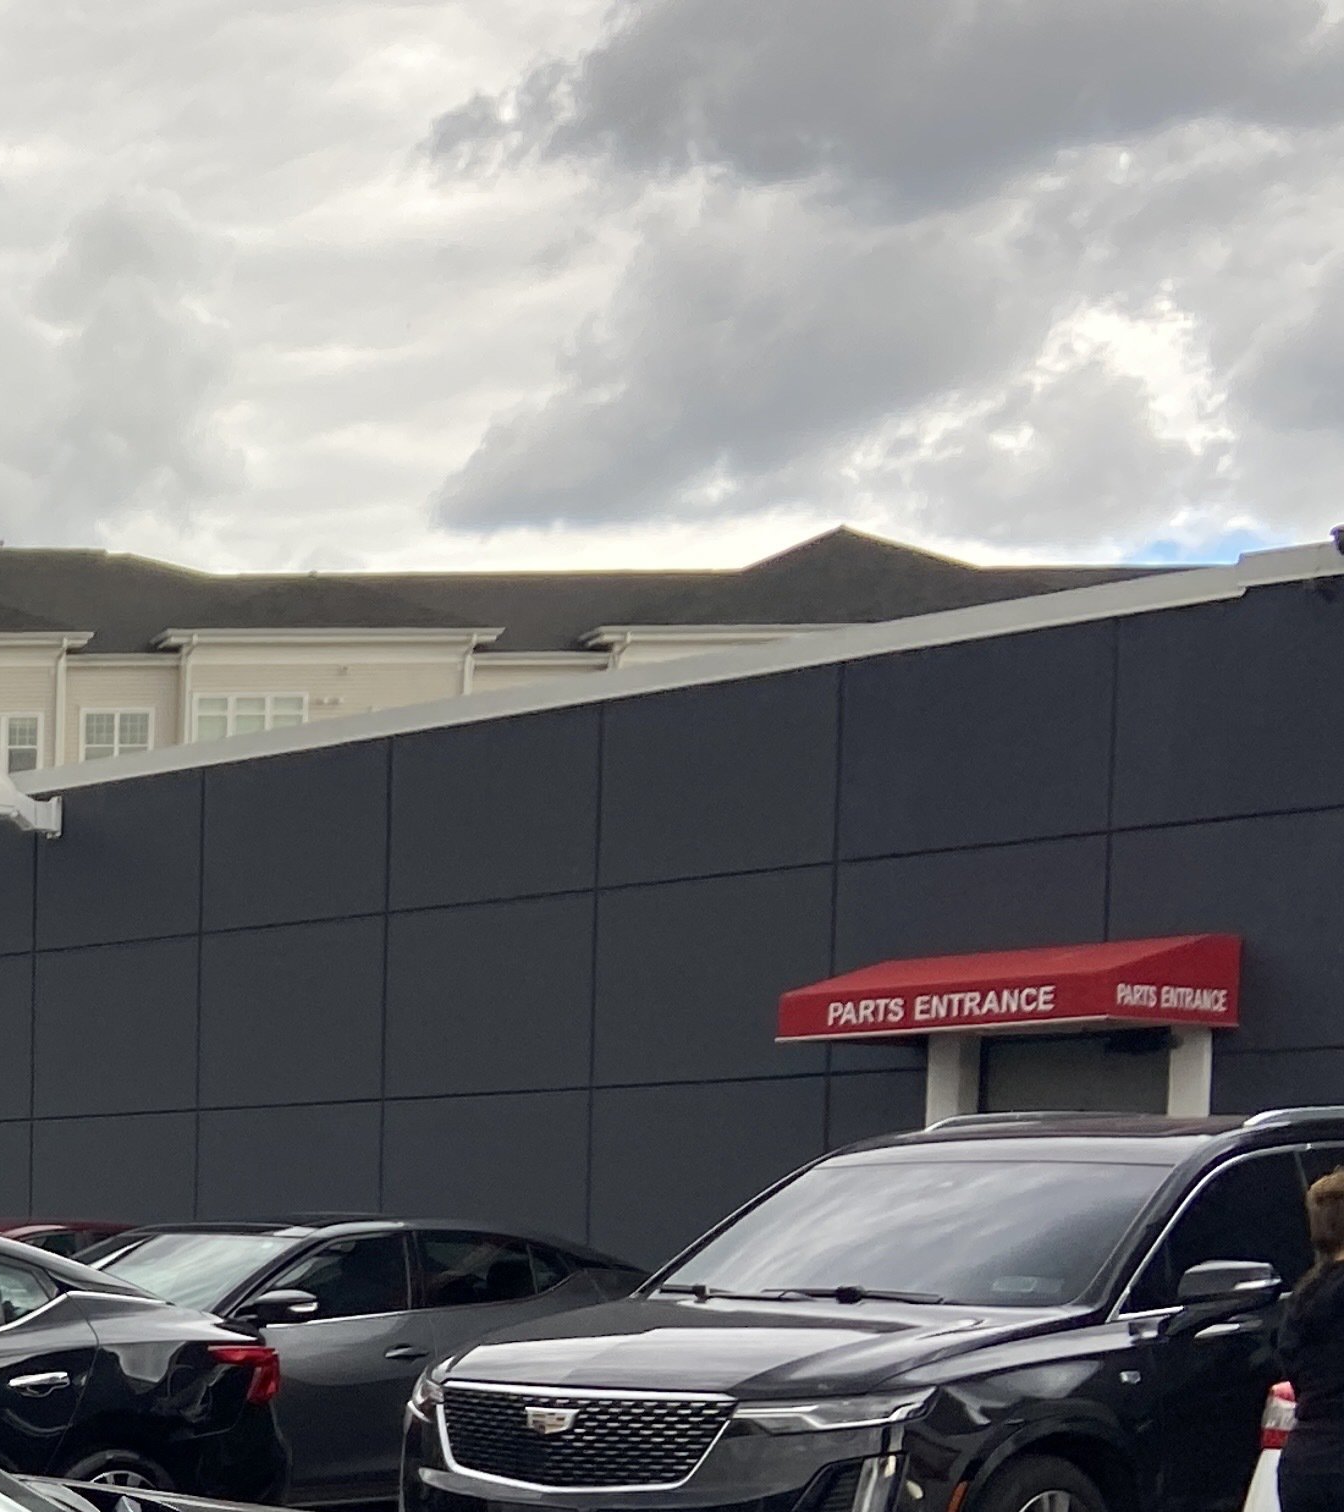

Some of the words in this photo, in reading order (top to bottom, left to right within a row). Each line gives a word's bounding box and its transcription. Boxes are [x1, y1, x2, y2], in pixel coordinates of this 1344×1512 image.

[827, 998, 905, 1026] PARTS
[914, 985, 1056, 1021] ENTRANCE
[1116, 982, 1157, 1008] PARTS
[1160, 986, 1229, 1012] ENTRANCE
